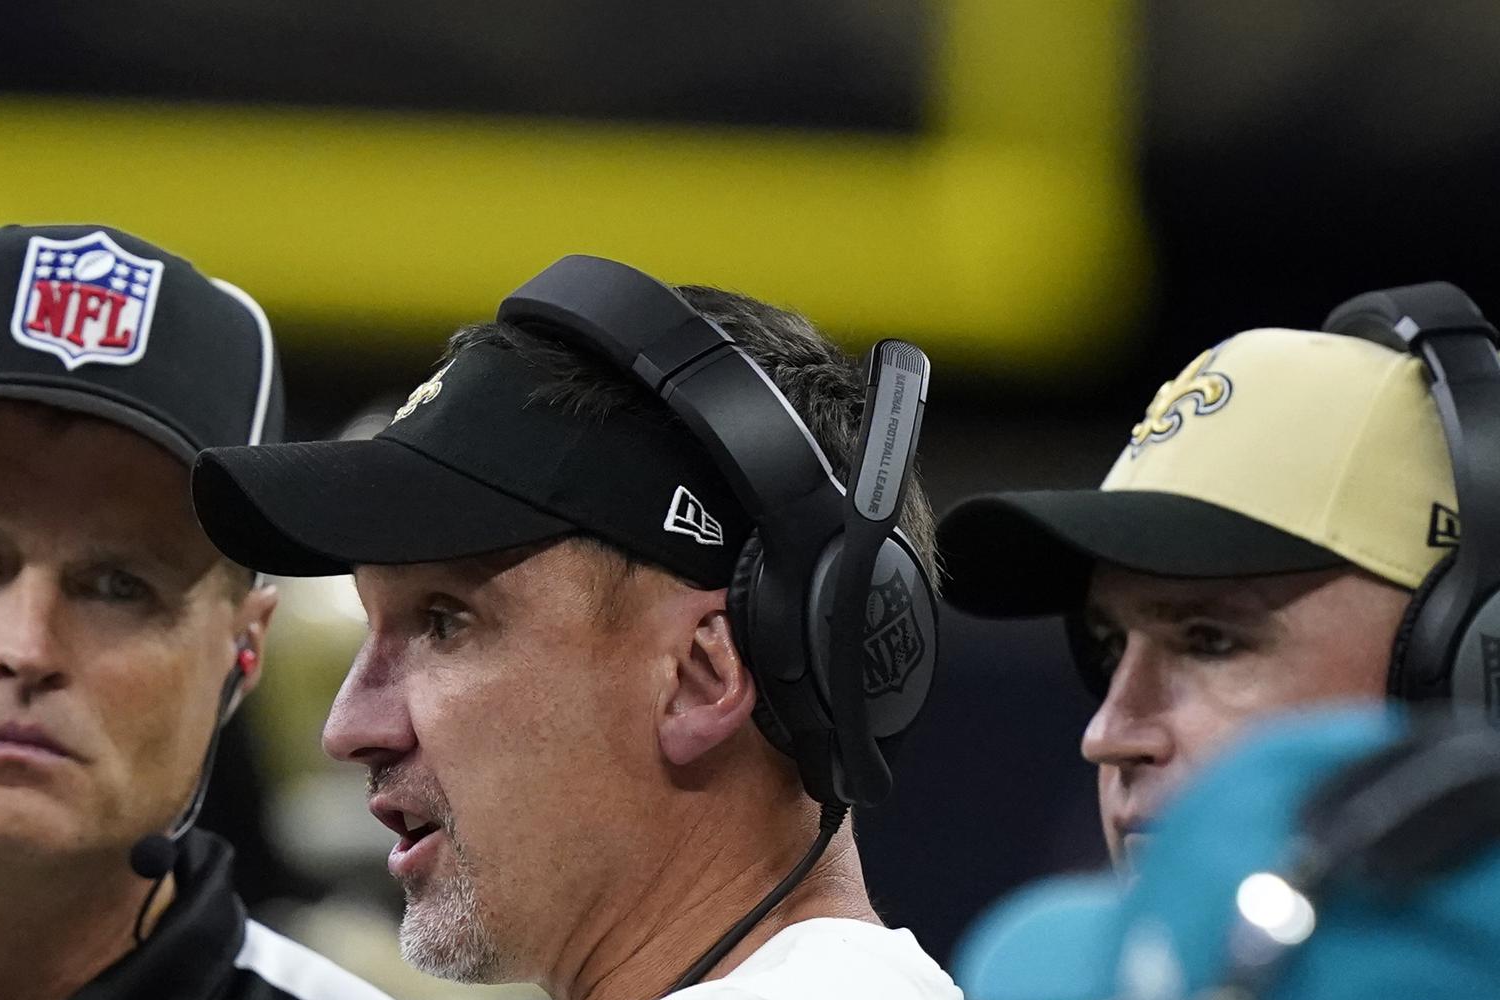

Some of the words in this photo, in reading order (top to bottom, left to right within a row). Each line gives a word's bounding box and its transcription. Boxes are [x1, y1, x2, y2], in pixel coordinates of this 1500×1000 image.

[27, 280, 133, 348] NFL
[891, 372, 906, 416] NATIONAL
[880, 416, 899, 468] FOOTBALL
[868, 469, 889, 514] LEAGUE
